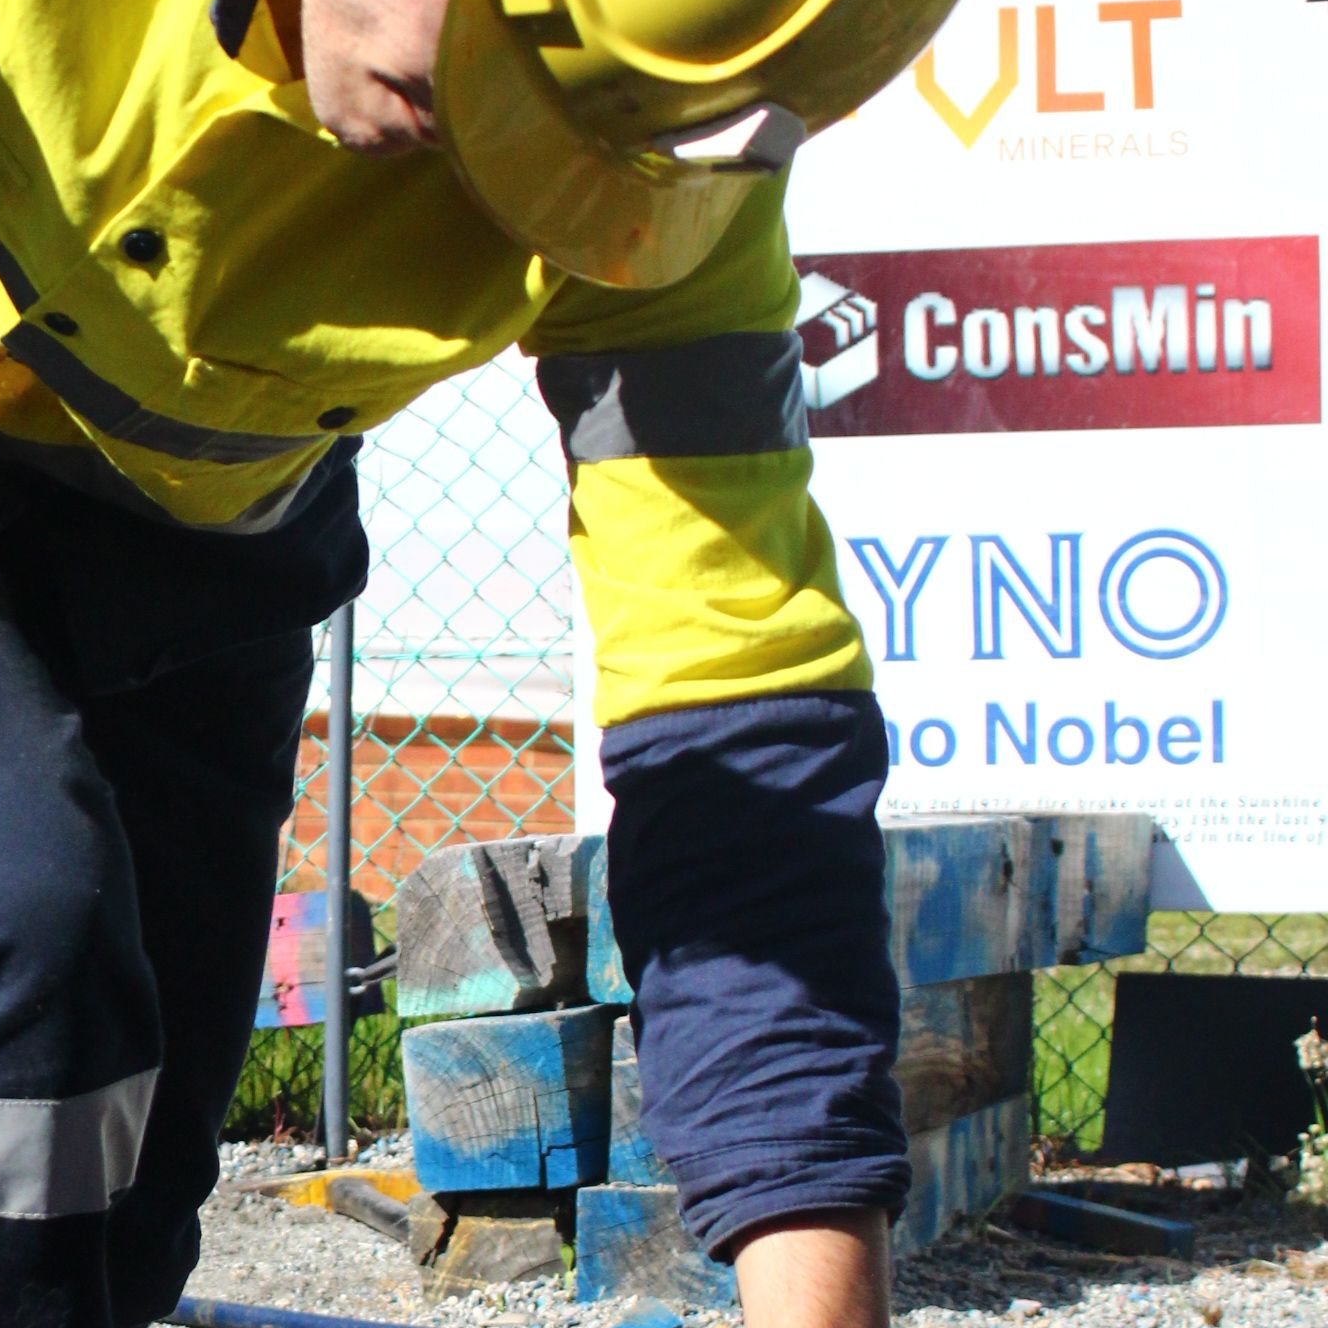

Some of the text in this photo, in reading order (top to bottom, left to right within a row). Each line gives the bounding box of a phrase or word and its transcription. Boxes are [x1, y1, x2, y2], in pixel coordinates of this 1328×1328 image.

[998, 130, 1189, 163] MINERALS
[904, 283, 1272, 380] ConsMin
[985, 699, 1225, 766] Nobel
[1078, 796, 1127, 810] broke
[1137, 798, 1167, 808] out
[1200, 795, 1229, 808] the
[1238, 795, 1321, 809] Sunshine
[1238, 812, 1266, 825] the
[1226, 830, 1255, 843] the
